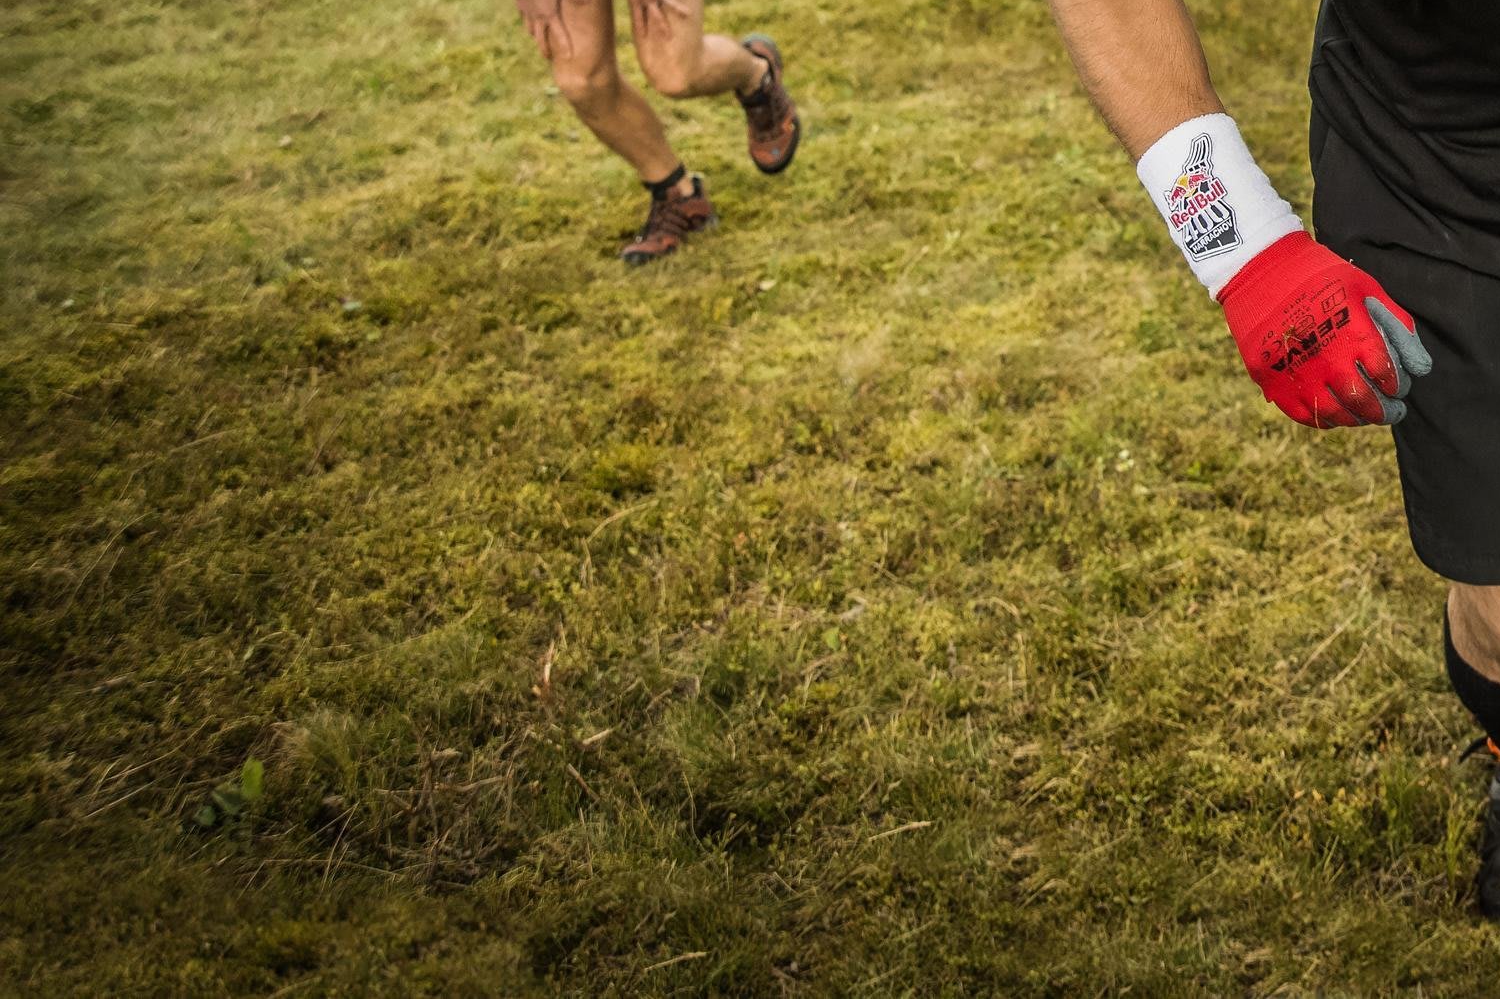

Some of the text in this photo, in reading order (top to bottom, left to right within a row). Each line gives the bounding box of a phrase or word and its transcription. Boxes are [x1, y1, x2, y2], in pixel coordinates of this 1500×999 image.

[1170, 180, 1225, 229] Red Bull
[1185, 200, 1231, 242] 400
[1192, 219, 1234, 253] HARRACHOV
